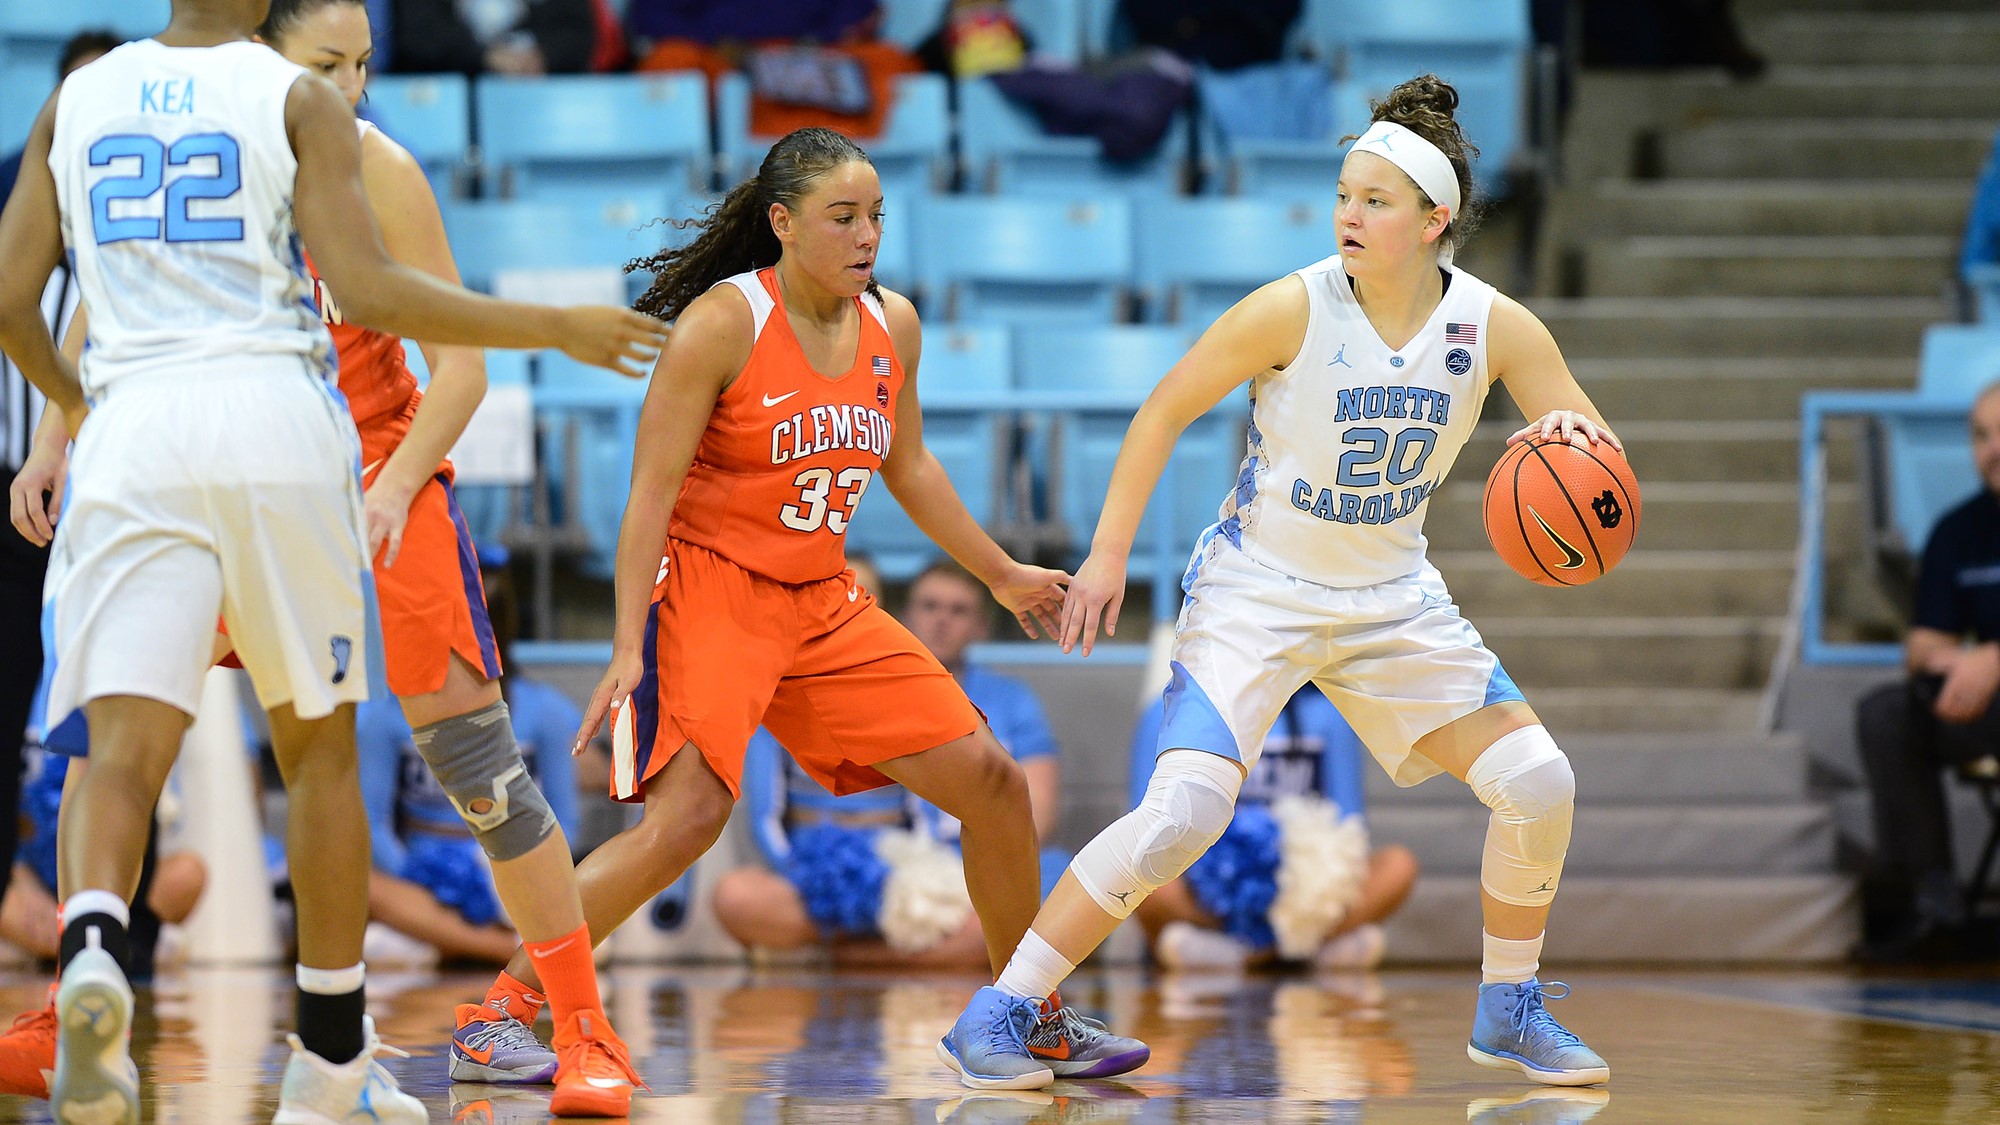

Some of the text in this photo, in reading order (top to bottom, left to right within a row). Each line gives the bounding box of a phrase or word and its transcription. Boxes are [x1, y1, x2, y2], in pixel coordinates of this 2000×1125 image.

[140, 78, 195, 114] KEA
[89, 131, 245, 246] 22
[770, 404, 892, 465] CLEMSON
[1334, 385, 1451, 426] NORTH
[1335, 426, 1439, 488] 20
[778, 465, 873, 536] 33
